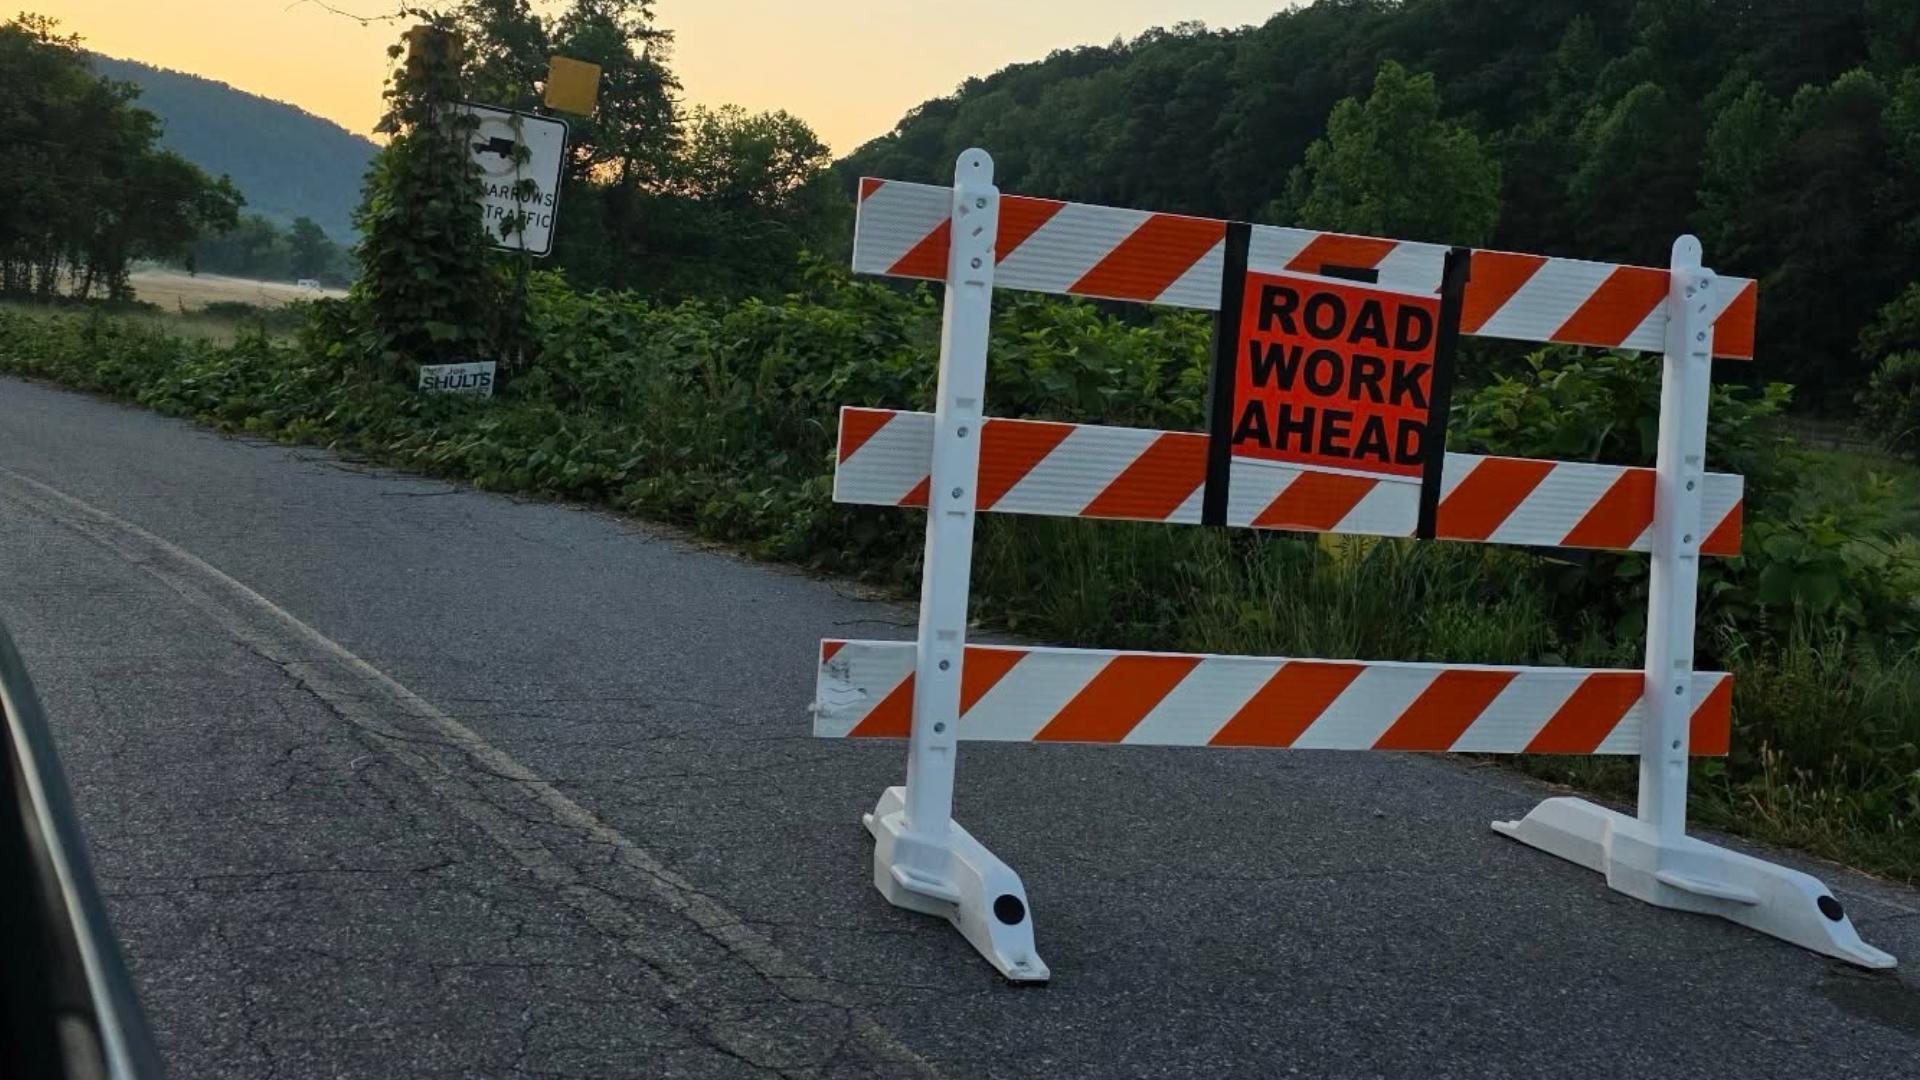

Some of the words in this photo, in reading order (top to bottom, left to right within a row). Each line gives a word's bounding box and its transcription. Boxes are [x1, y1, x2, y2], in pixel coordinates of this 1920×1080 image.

[1258, 284, 1433, 351] ROAD
[423, 372, 491, 390] SHULTS
[1249, 340, 1432, 409] WORK
[1232, 400, 1428, 466] AHEAD
